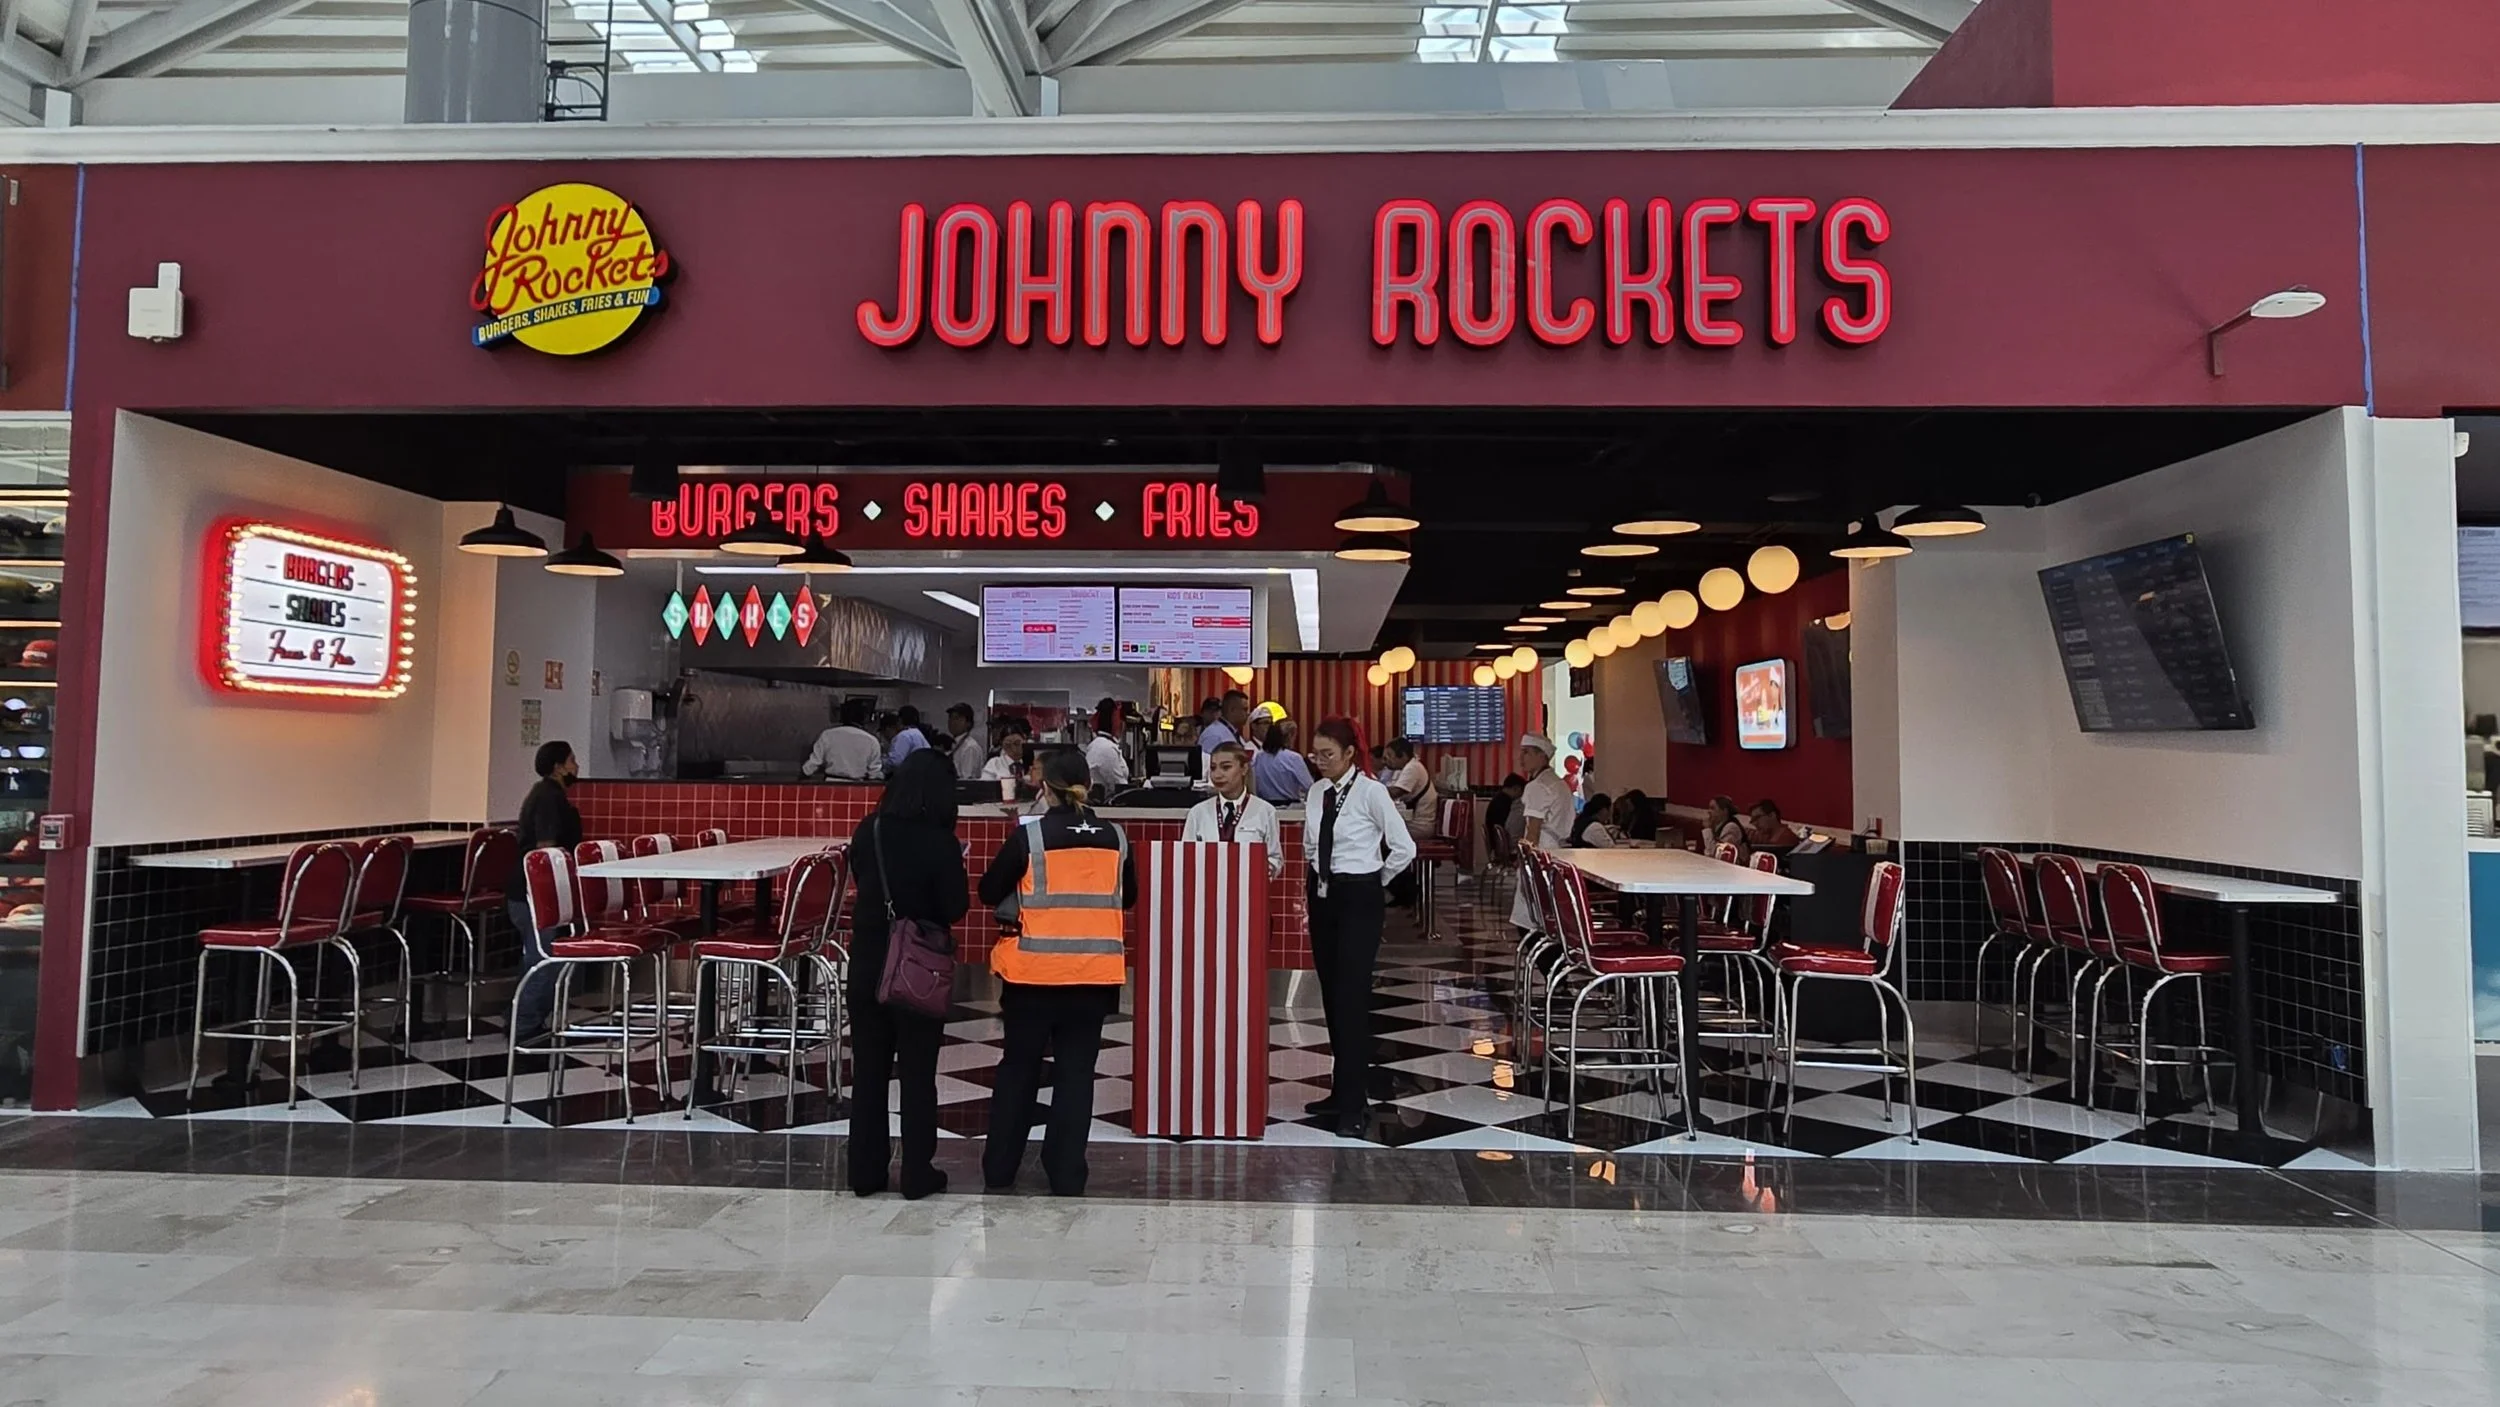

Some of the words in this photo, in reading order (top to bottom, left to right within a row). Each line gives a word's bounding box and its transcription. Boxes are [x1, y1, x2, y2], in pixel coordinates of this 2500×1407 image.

[470, 200, 645, 310] Johnny
[491, 240, 669, 316] Rockets
[855, 199, 1304, 347] JOHNNY
[1372, 197, 1892, 346] ROCKETS
[580, 294, 612, 313] FRIES
[613, 292, 624, 307] &
[626, 289, 650, 305] FUN
[904, 482, 1067, 537] SHAKES
[1142, 482, 1259, 537] FRIES
[283, 553, 355, 591] BURGERS
[669, 602, 811, 629] SHAKES
